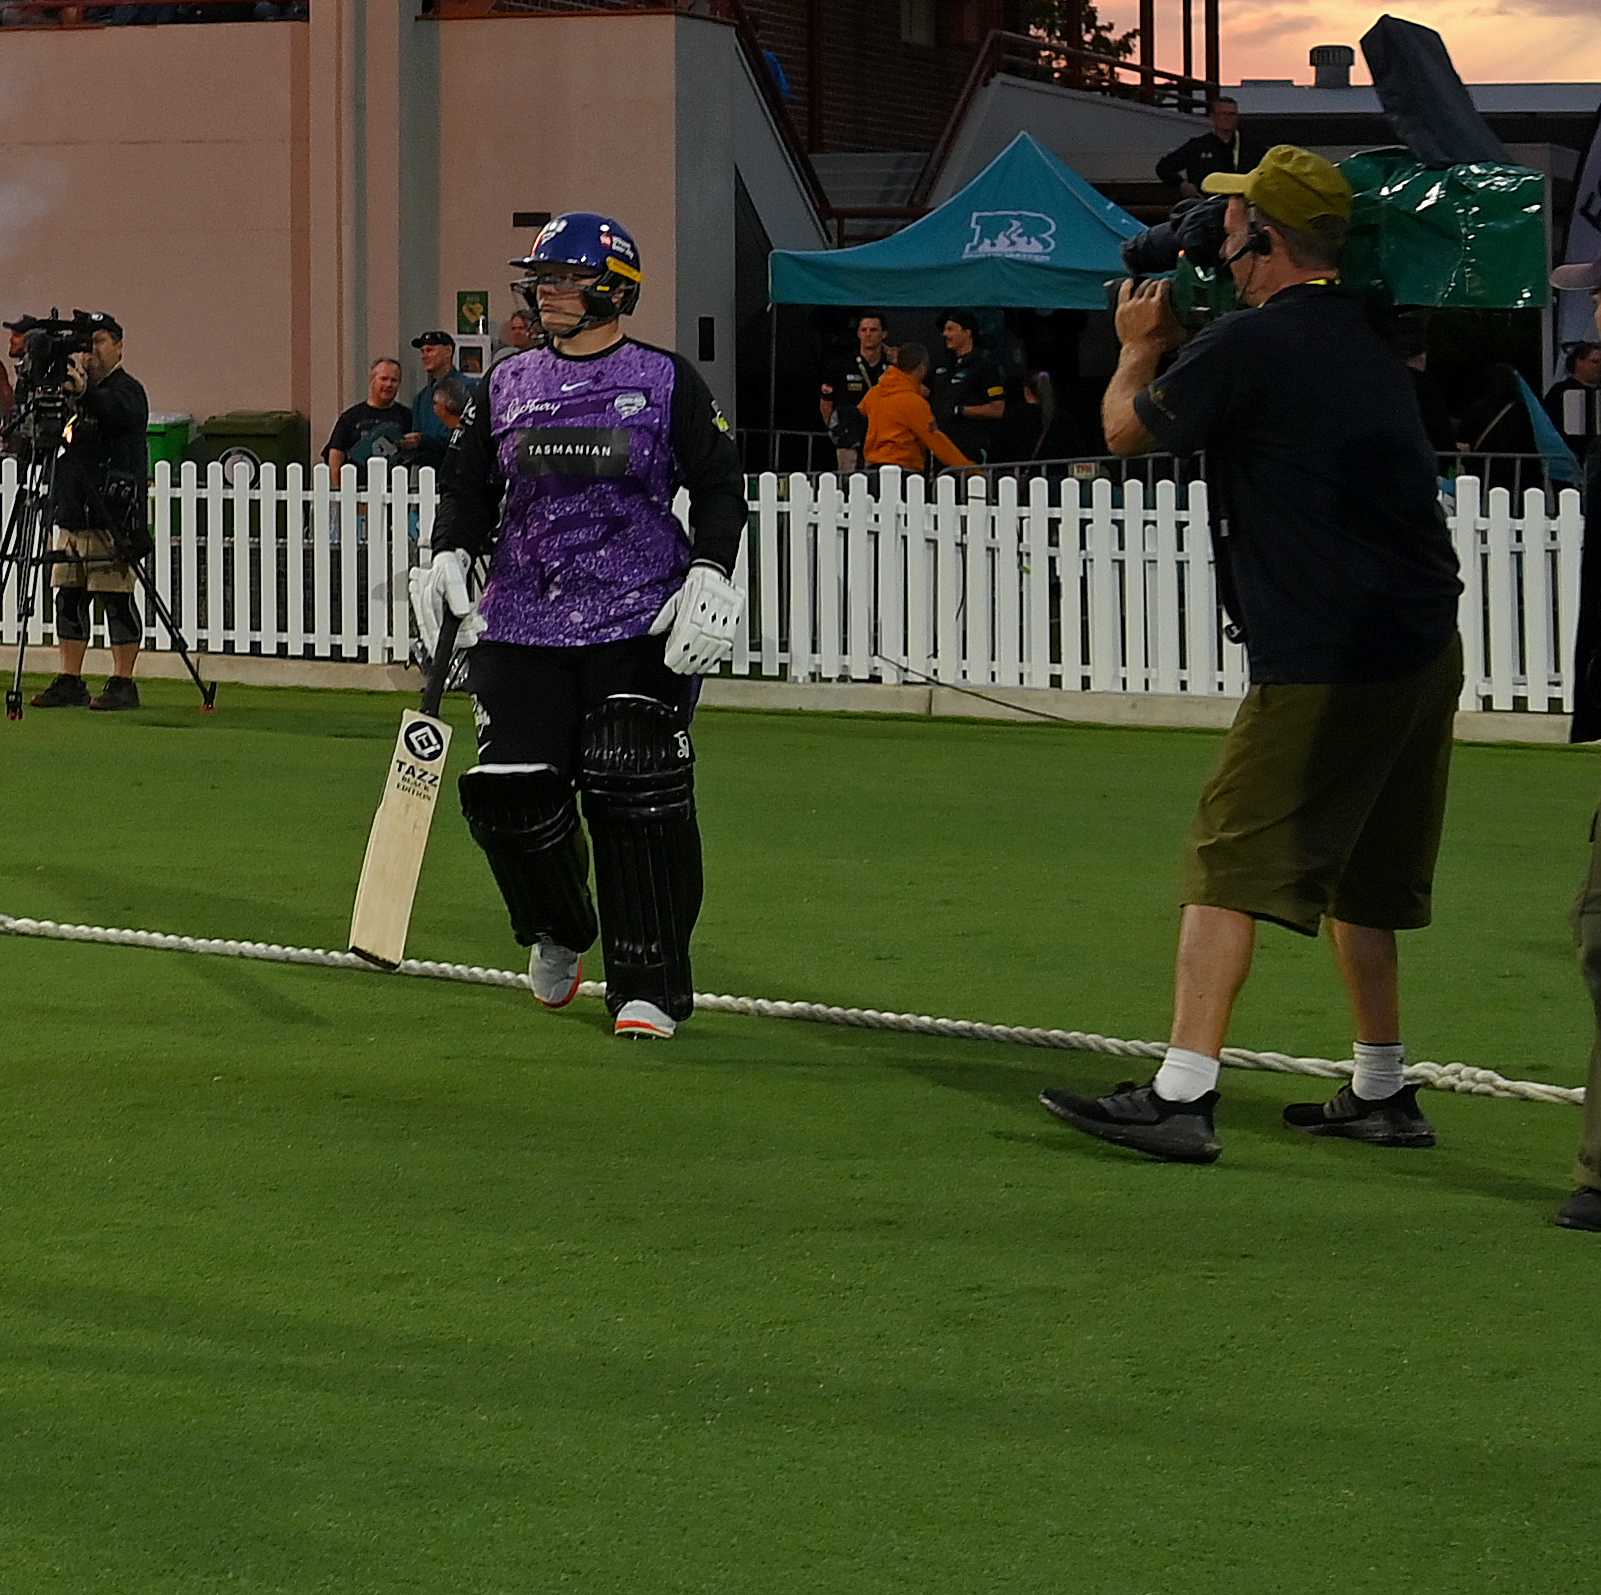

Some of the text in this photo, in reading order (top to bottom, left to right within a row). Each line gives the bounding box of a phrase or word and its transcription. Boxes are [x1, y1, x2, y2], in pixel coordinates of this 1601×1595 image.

[506, 397, 561, 423] Cadbury
[528, 444, 611, 457] TASMANIAN
[396, 759, 439, 787] TAZZ
